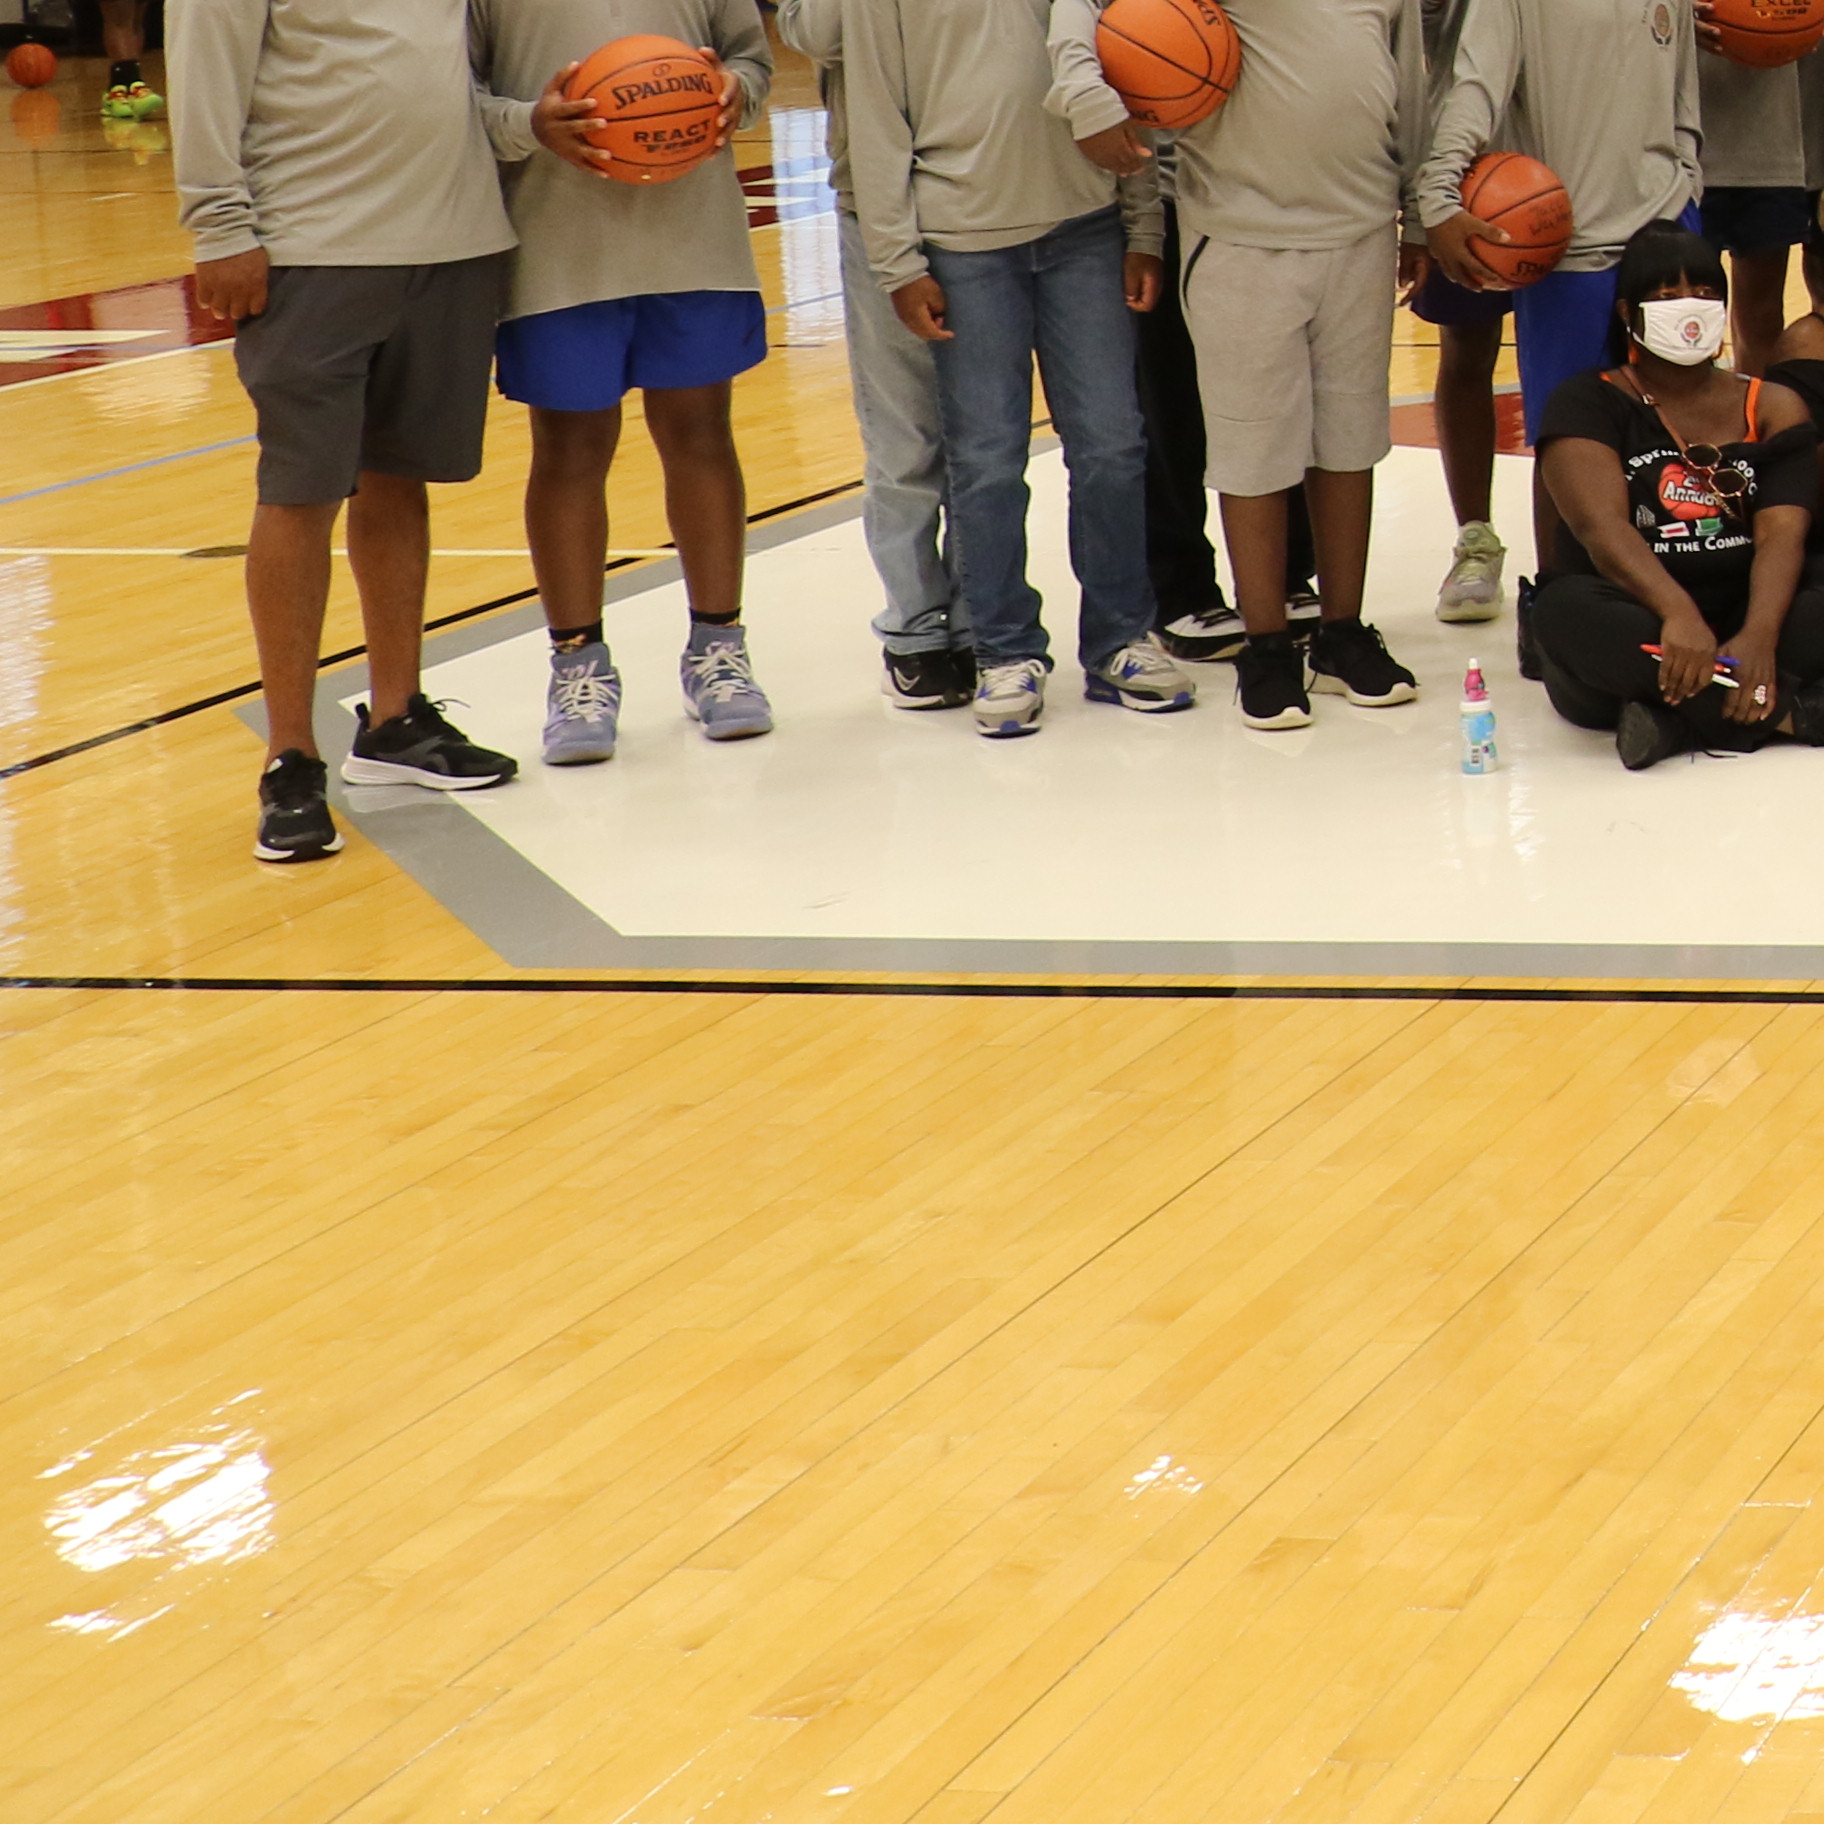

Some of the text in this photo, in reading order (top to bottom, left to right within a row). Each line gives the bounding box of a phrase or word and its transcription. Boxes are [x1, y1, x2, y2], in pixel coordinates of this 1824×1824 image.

[612, 73, 713, 110] SPALDING
[633, 119, 711, 144] REACT
[1654, 542, 1669, 553] IN
[1676, 542, 1700, 553] THE
